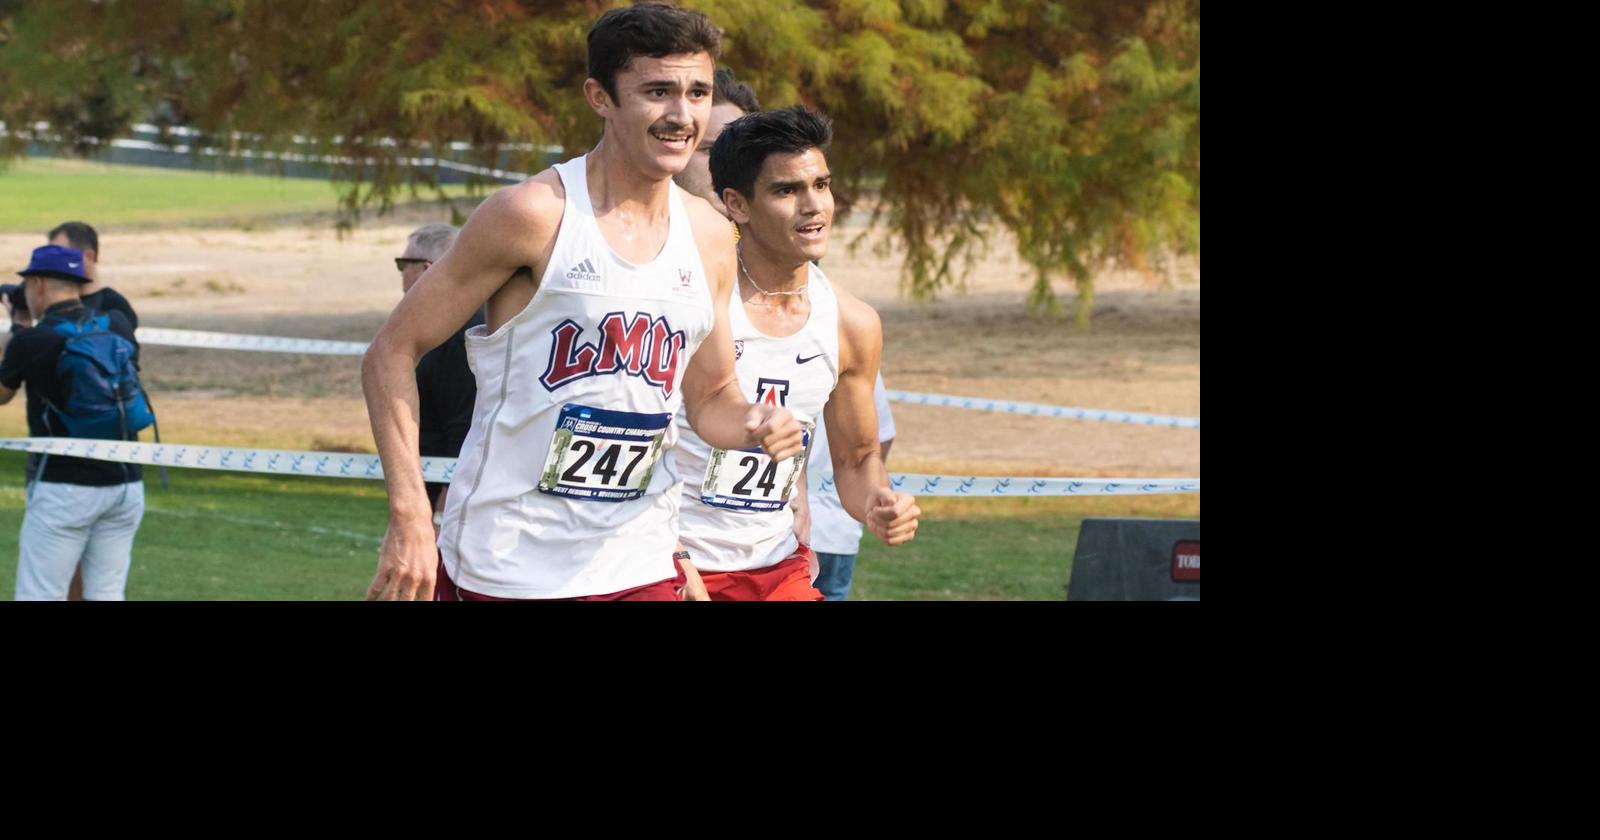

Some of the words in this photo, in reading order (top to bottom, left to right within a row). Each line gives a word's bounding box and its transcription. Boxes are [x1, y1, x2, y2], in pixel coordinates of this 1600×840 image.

[566, 272, 601, 281] adidas
[539, 311, 686, 400] LMU
[574, 422, 598, 433] CROSS
[597, 425, 626, 435] COUNTRY
[561, 440, 649, 486] 247
[732, 456, 779, 497] 24
